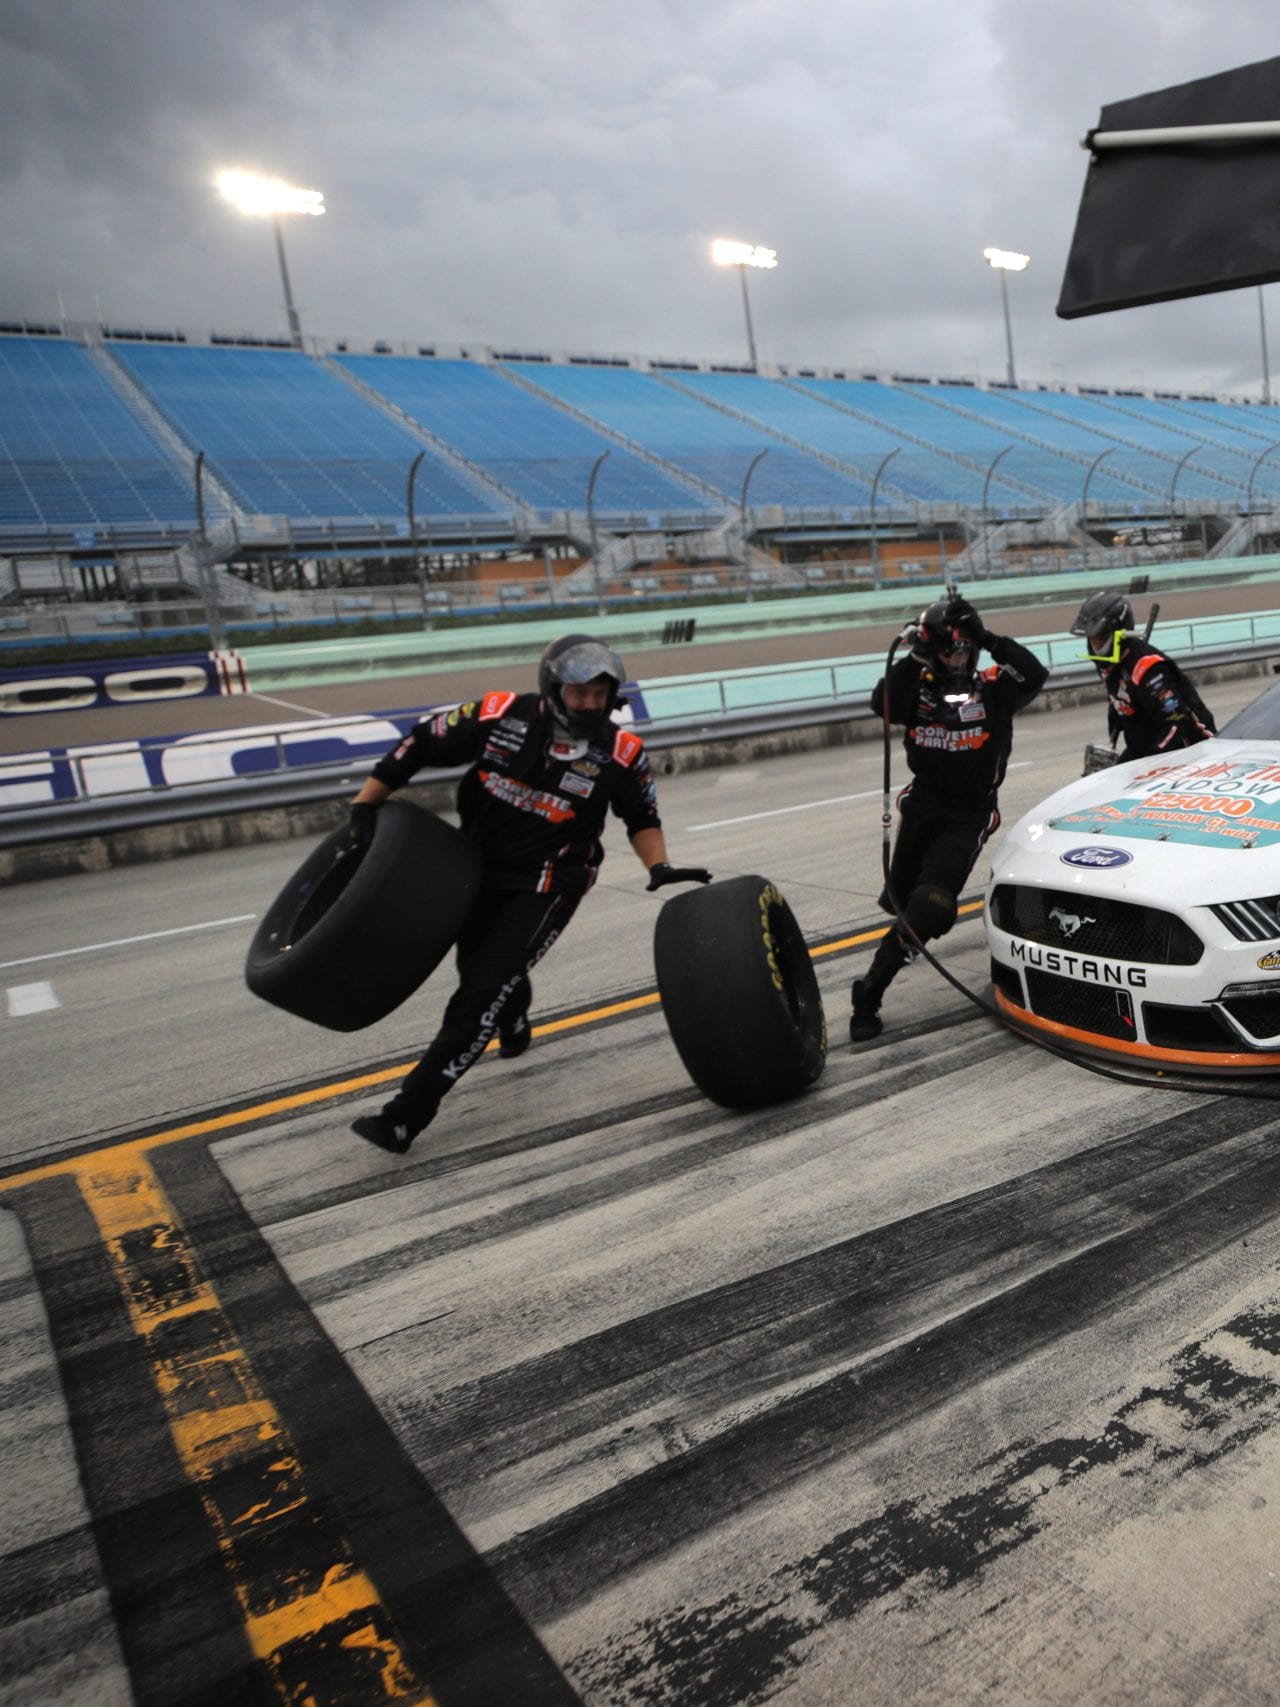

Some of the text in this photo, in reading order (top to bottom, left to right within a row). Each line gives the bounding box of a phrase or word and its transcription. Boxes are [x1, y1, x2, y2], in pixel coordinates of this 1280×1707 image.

[915, 726, 983, 741] CORVETTE
[915, 736, 957, 752] PARTS
[487, 772, 571, 812] CORVETTE
[1142, 810, 1207, 824] WINDOW
[1010, 940, 1147, 988] MUSTANG
[442, 929, 560, 1079] KeenPartscom
